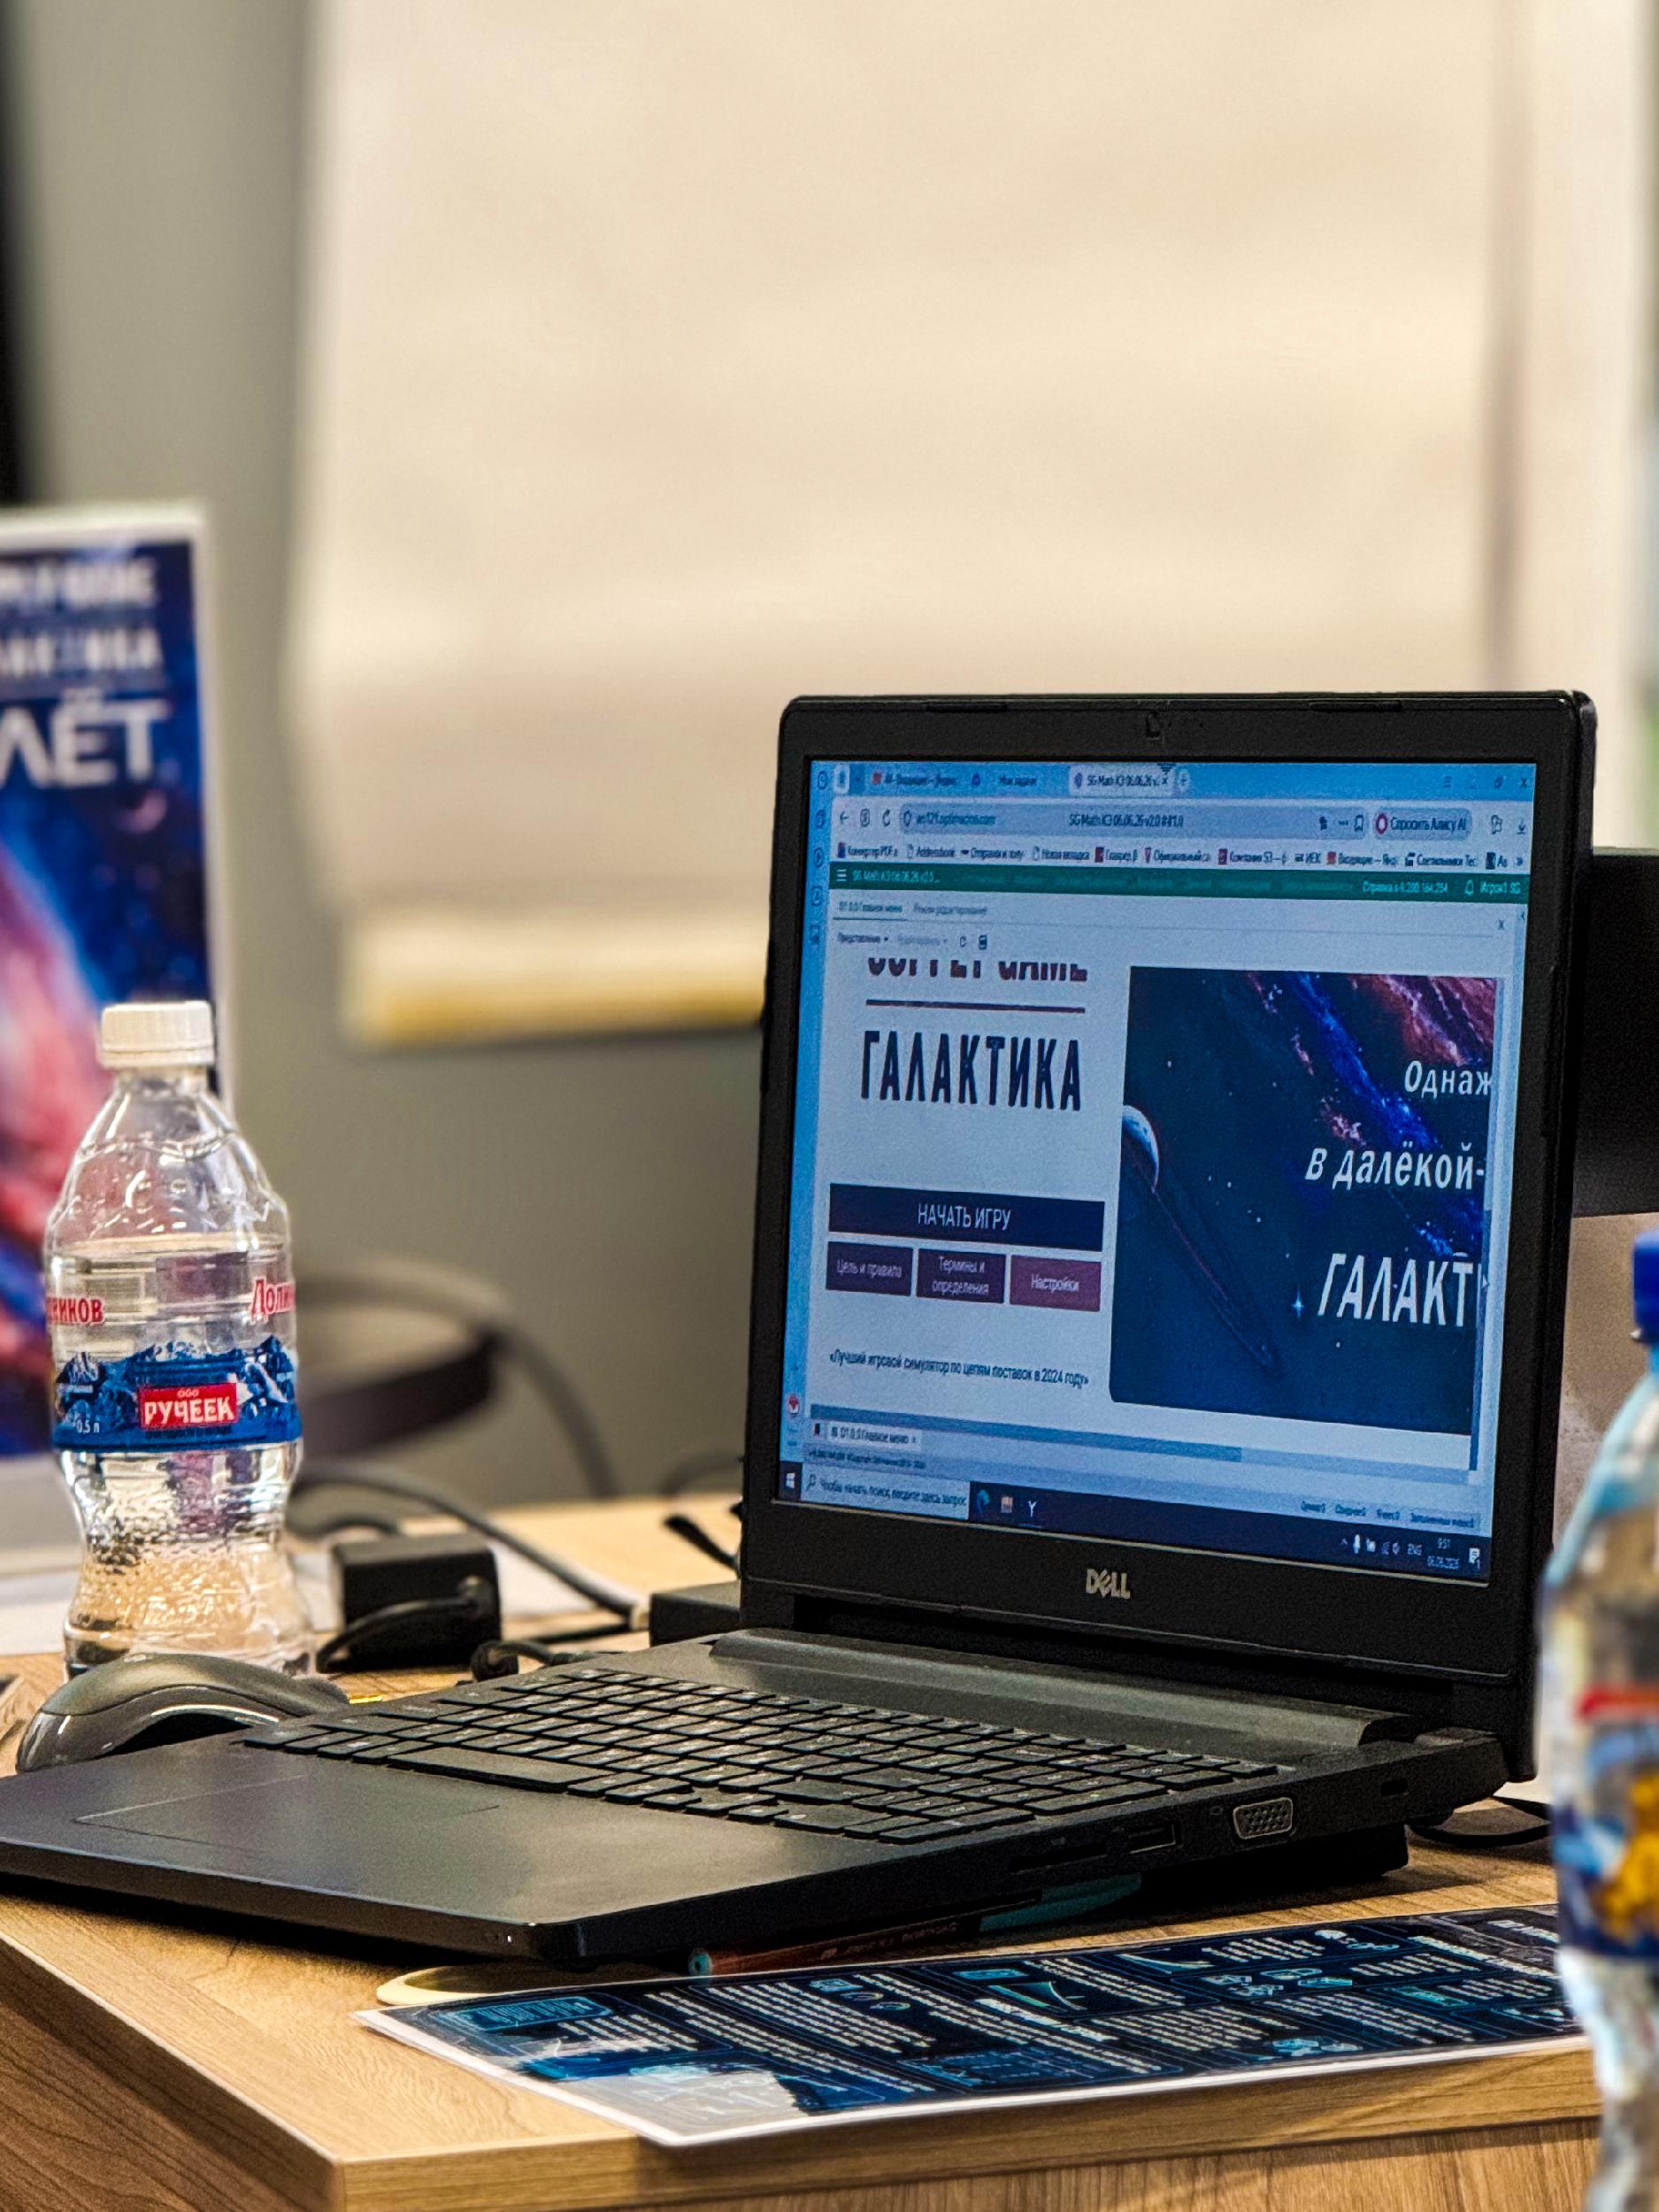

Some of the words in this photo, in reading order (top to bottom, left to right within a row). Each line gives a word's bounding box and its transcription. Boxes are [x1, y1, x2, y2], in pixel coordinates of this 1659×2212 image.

[861, 1030, 1081, 1111] ГАЛАКТИКА
[1404, 1060, 1493, 1100] Однаж
[918, 1202, 972, 1228] НАЧАТЬ
[974, 1207, 1011, 1231] ИГРУ
[837, 1259, 858, 1276] Цель
[867, 1263, 902, 1279] правила
[939, 1256, 978, 1274] Термины
[932, 1279, 989, 1296] определения
[1031, 1273, 1079, 1294] Настройки
[1317, 1252, 1482, 1327] ГАЛАКТ
[1041, 1368, 1063, 1383] 2024
[143, 1396, 235, 1425] РУЧЕЕК
[1086, 1568, 1132, 1600] DELL
